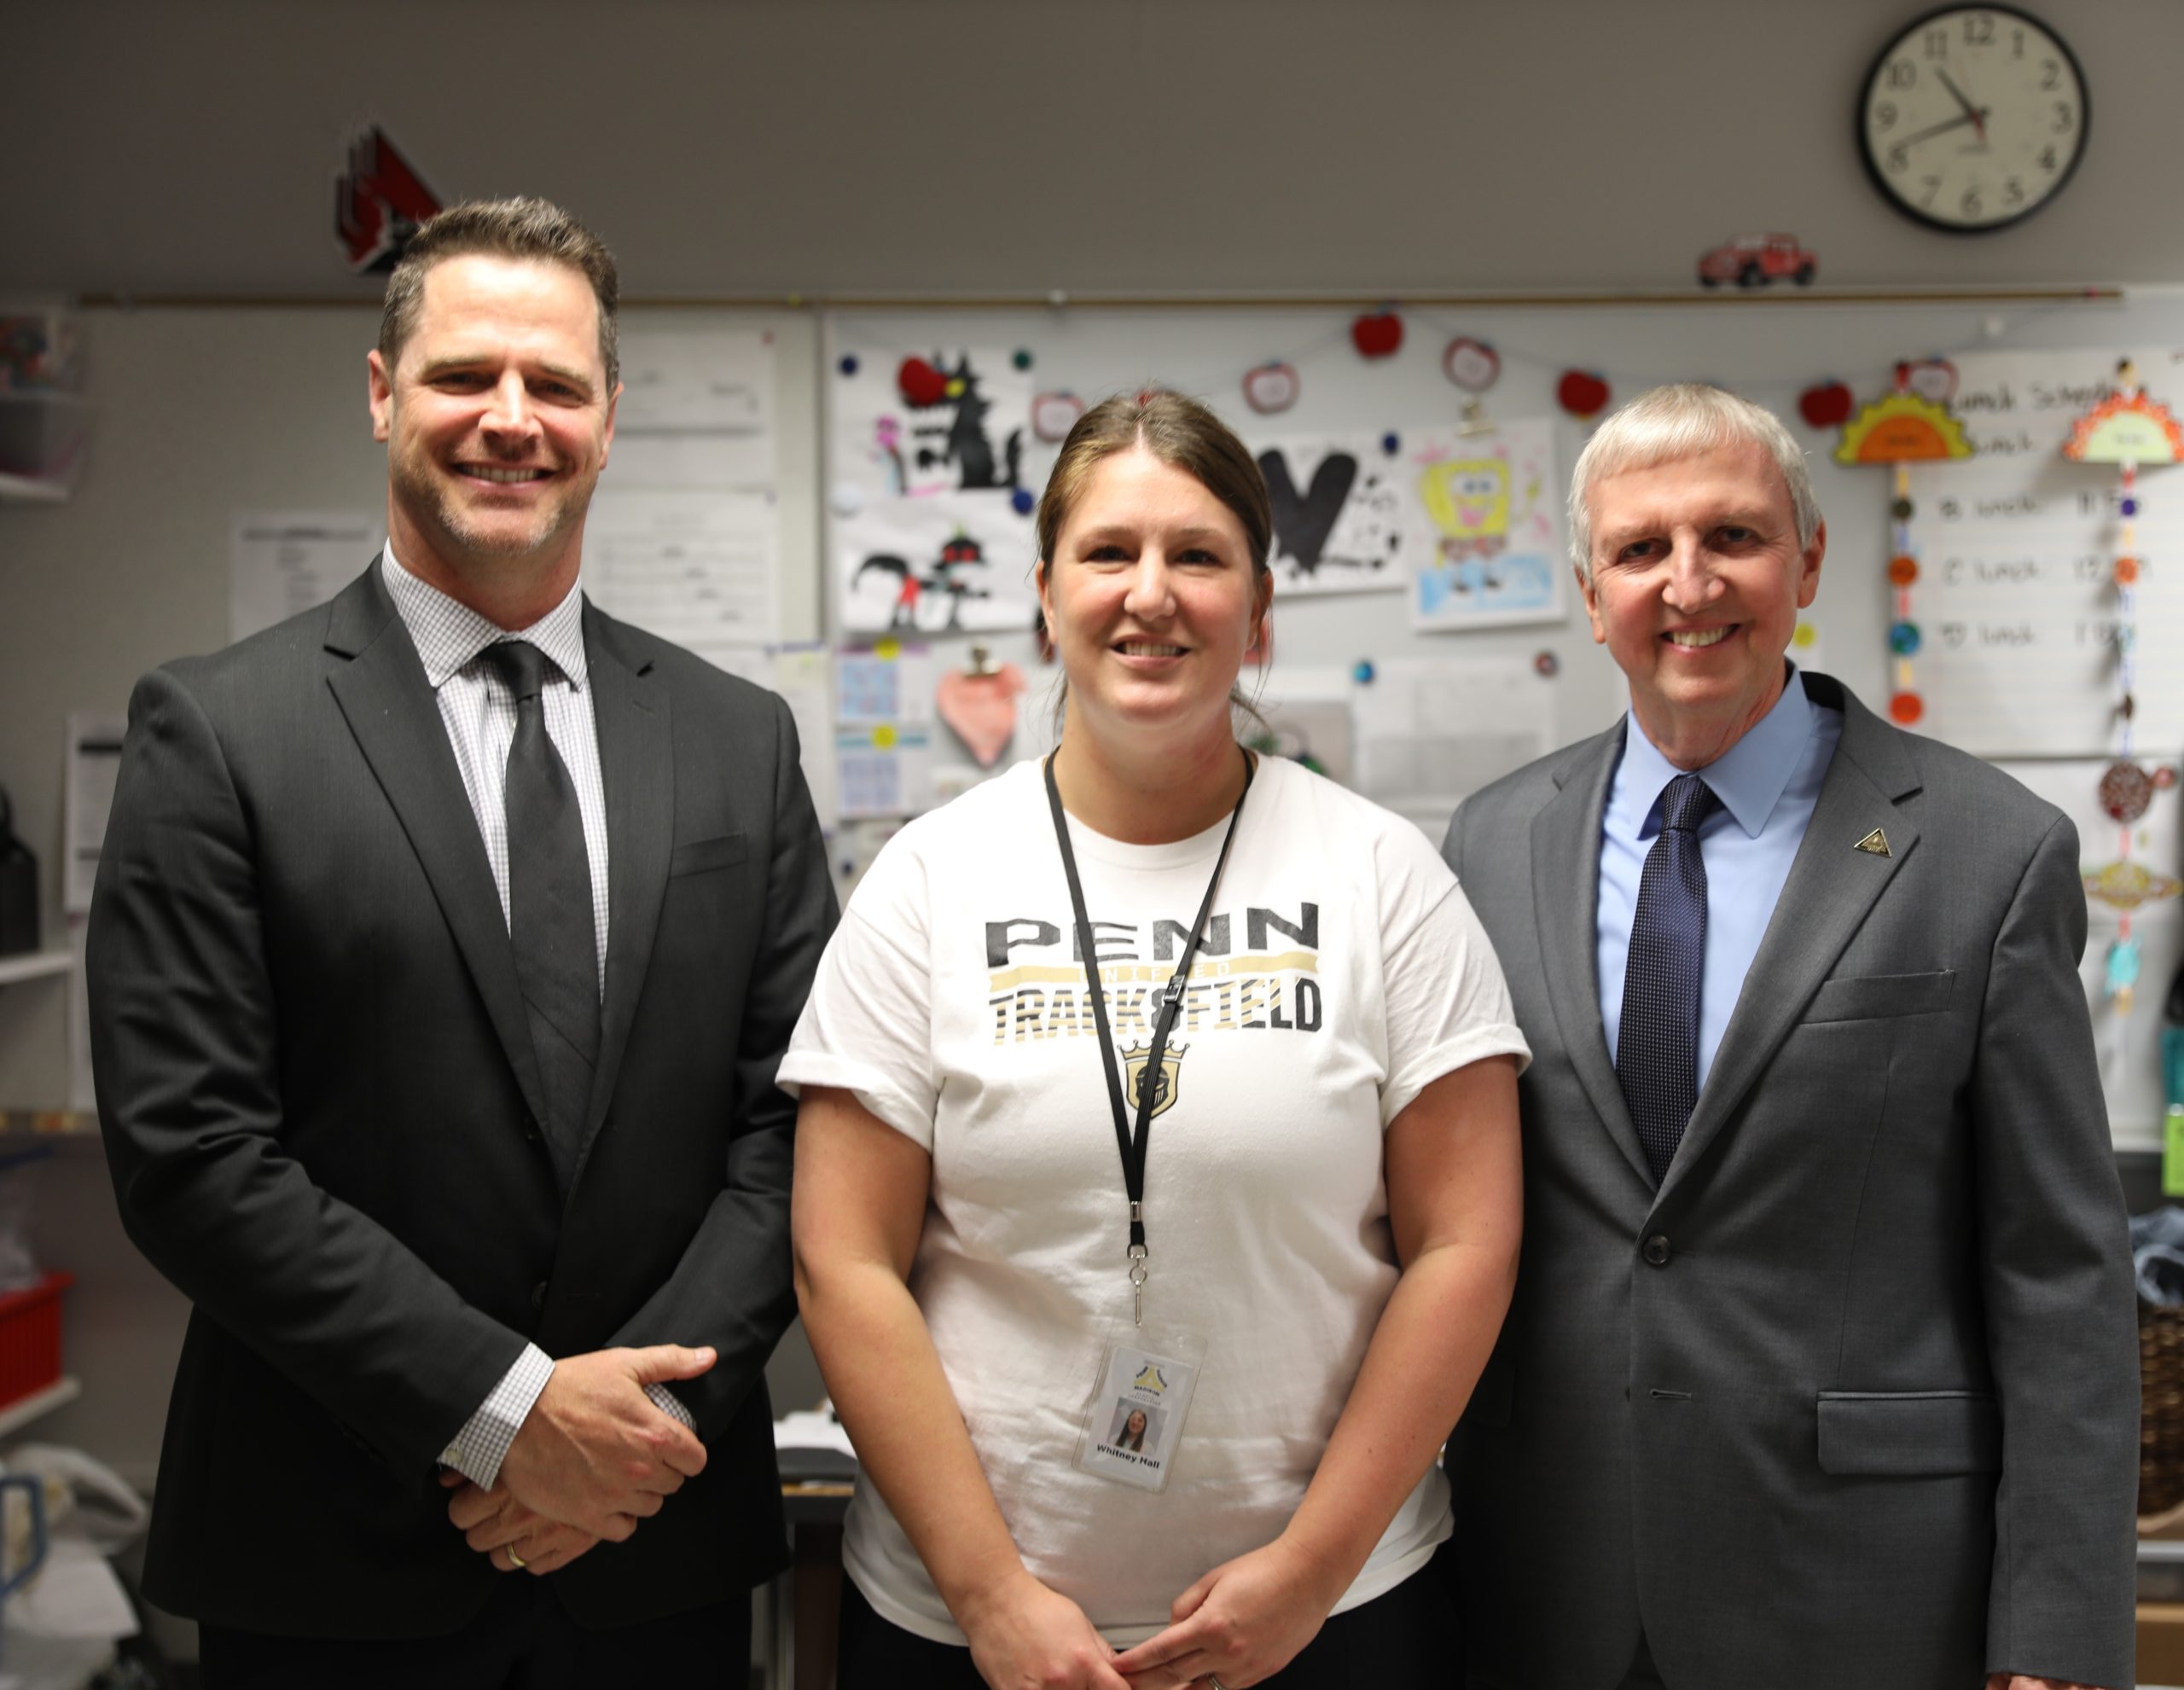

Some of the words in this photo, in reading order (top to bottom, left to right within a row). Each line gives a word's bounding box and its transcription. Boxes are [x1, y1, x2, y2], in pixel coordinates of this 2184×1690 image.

[1925, 29, 1948, 60] 11
[1963, 13, 1996, 47] 12
[2012, 29, 2024, 60] 1
[1885, 58, 1917, 91] 10
[2041, 58, 2059, 91] 2
[1879, 101, 1899, 131] 9
[2053, 100, 2073, 134] 3
[1888, 143, 1909, 174] 8
[2037, 145, 2056, 175] 4
[1922, 175, 1943, 209] 7
[1960, 185, 1983, 218] 6
[2002, 176, 2024, 206] 5
[985, 902, 1319, 968] PENN
[1097, 1443, 1137, 1463] Whitney
[1139, 1456, 1160, 1470] Hall
